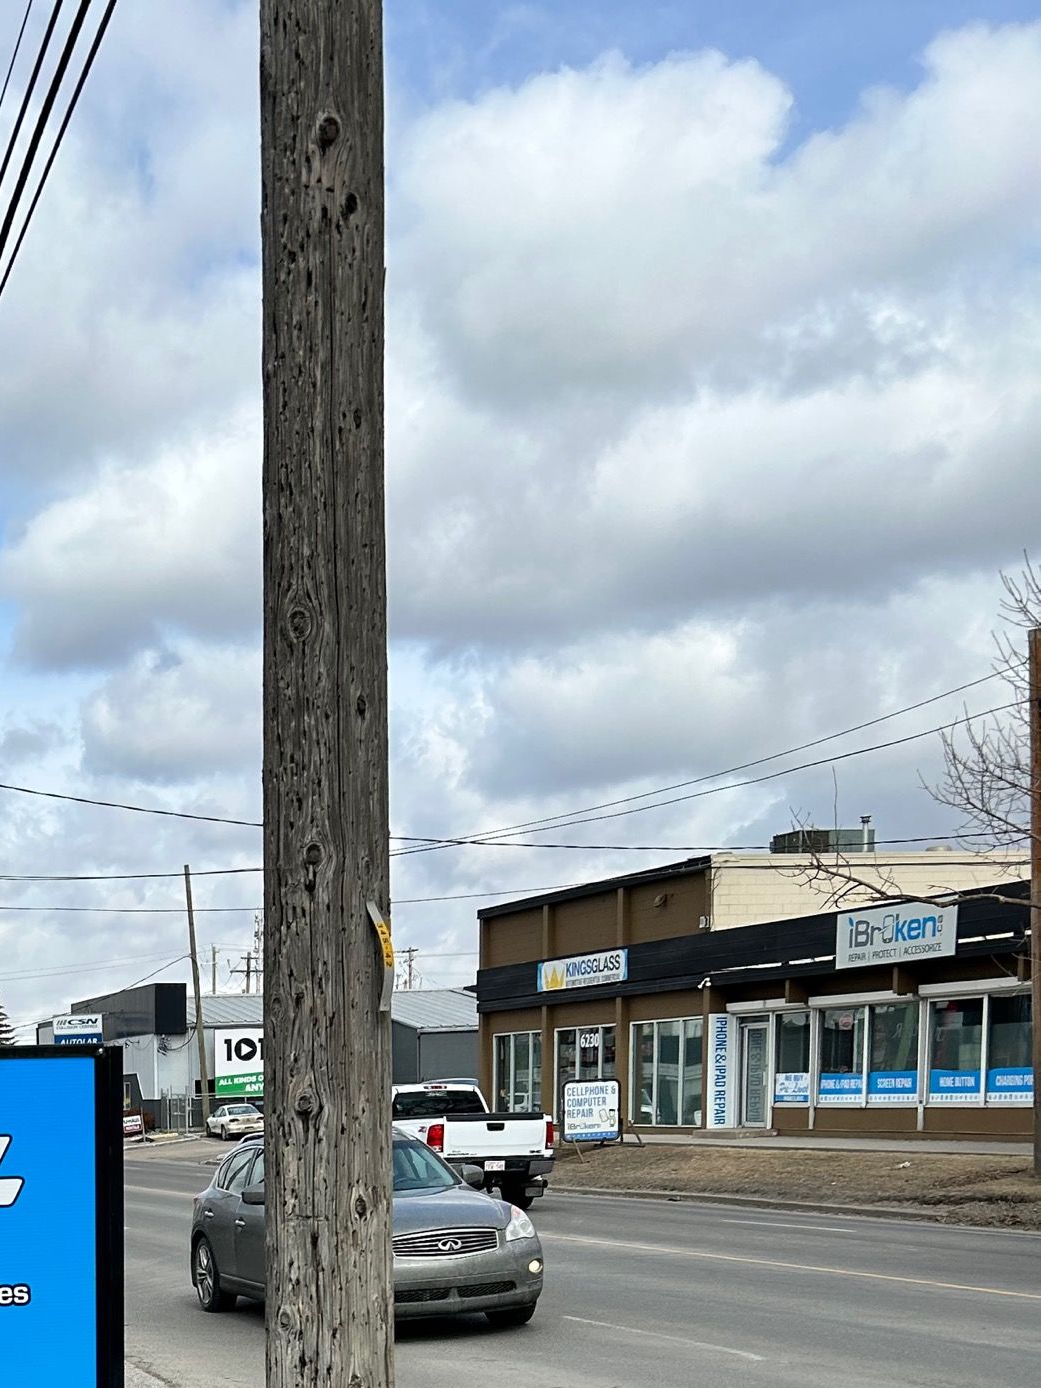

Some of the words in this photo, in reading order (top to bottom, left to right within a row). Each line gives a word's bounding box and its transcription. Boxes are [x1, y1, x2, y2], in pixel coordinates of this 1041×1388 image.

[872, 948, 897, 960] PROTECT
[903, 943, 942, 955] ACCESSORIZE
[566, 954, 621, 978] KINGSGLASS
[580, 1033, 599, 1048] 6230
[715, 1017, 728, 1053] IPHONE
[714, 1053, 727, 1064] &
[714, 1065, 727, 1089] IPAD
[567, 1086, 609, 1097] CELLPHONE
[611, 1085, 616, 1094] &
[567, 1097, 607, 1108] COMPUTER
[713, 1090, 726, 1125] REPAIR
[567, 1108, 594, 1119] REPAIR
